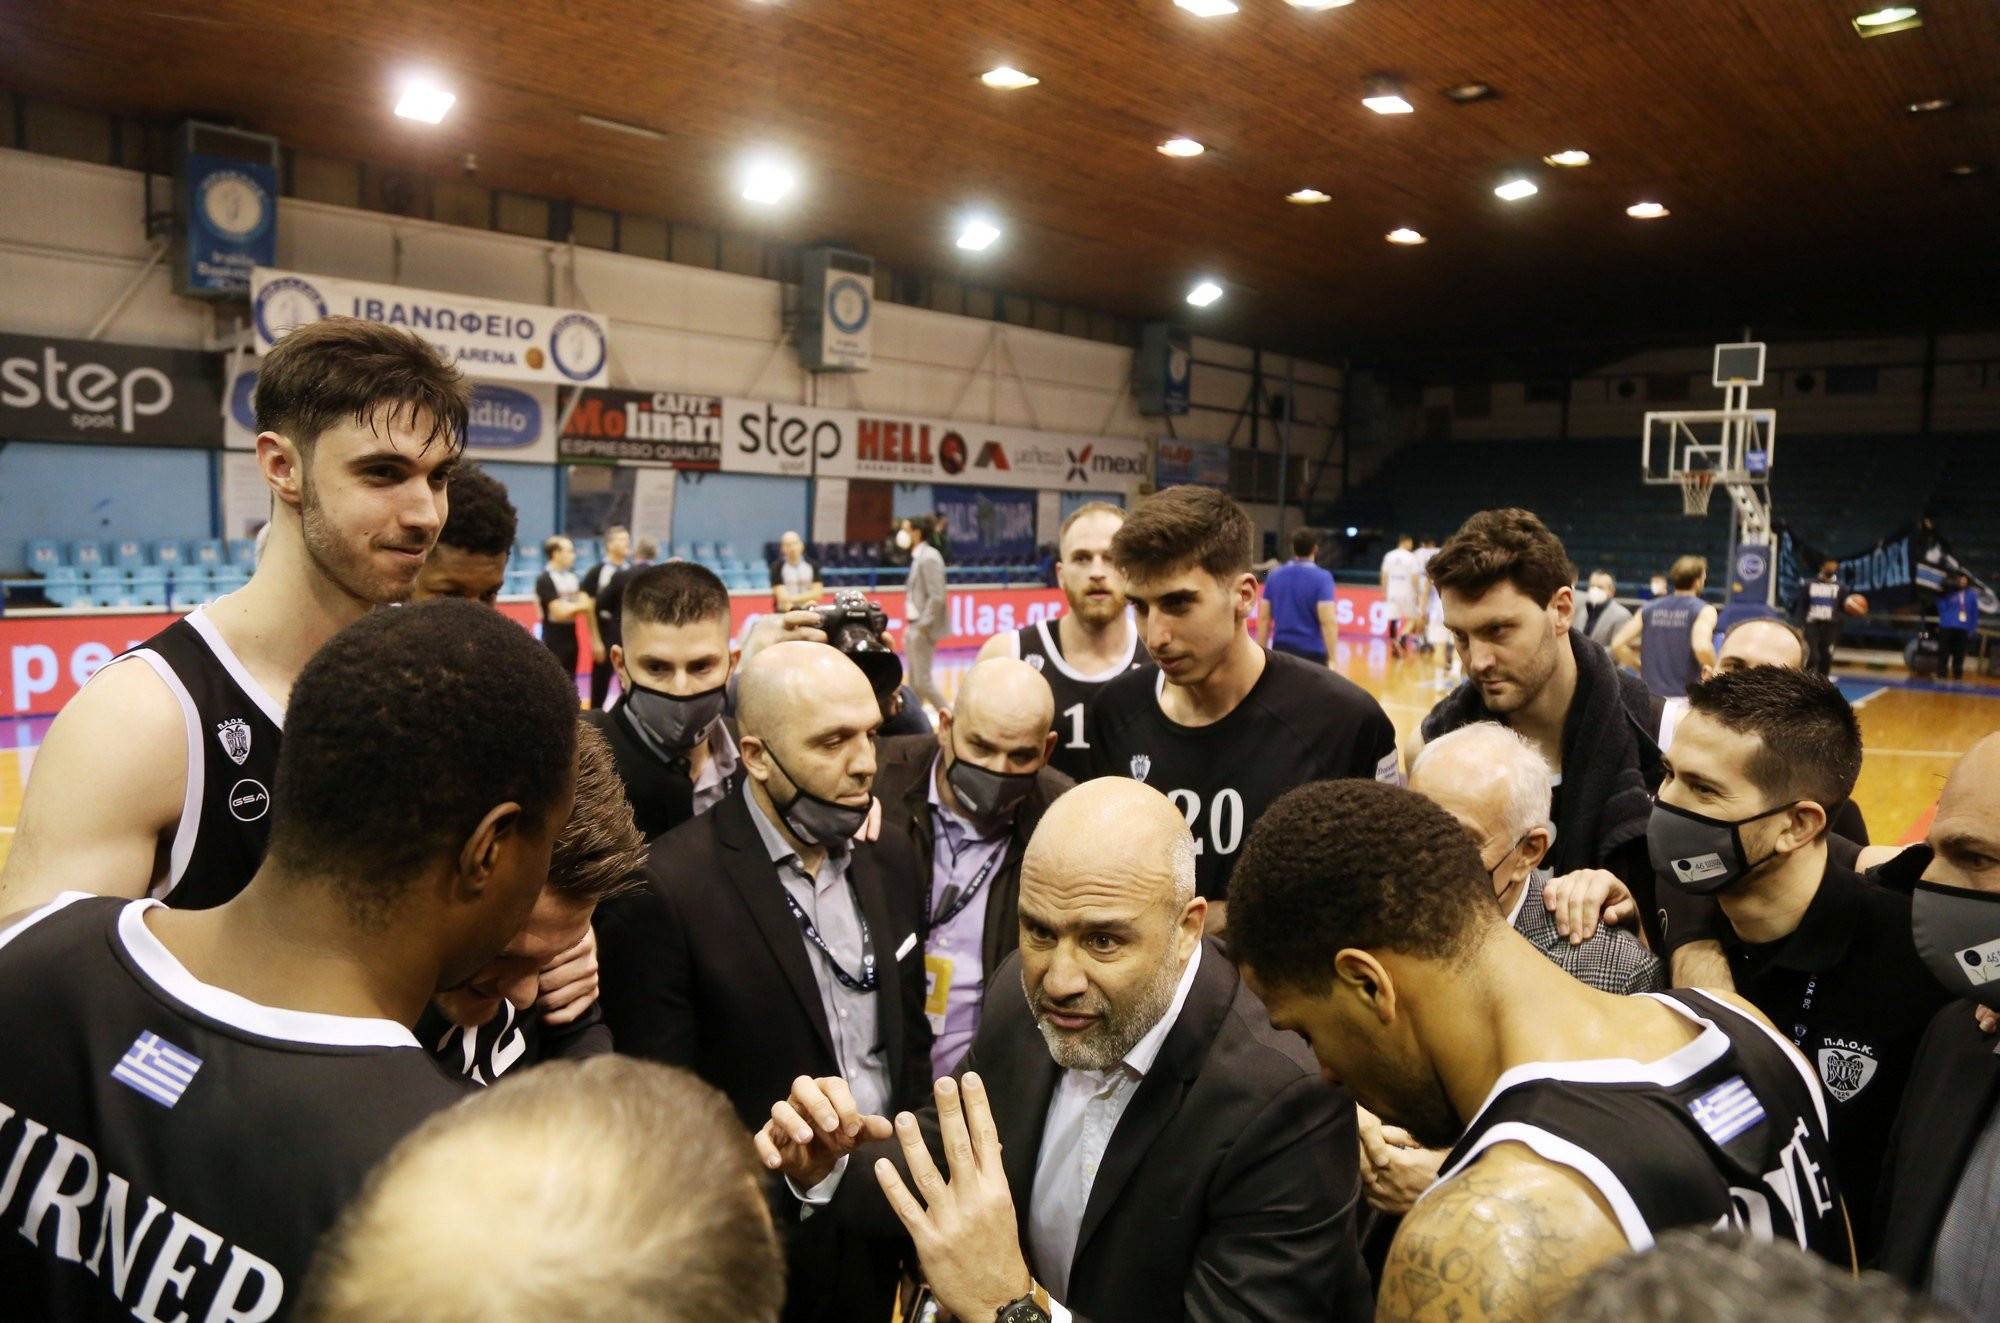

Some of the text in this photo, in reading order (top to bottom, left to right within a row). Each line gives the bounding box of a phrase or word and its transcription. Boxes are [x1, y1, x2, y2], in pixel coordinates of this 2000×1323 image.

[0, 346, 174, 433] step
[738, 403, 841, 476] step
[856, 418, 934, 464] HELL
[232, 793, 266, 807] GSA
[1167, 788, 1244, 855] 20
